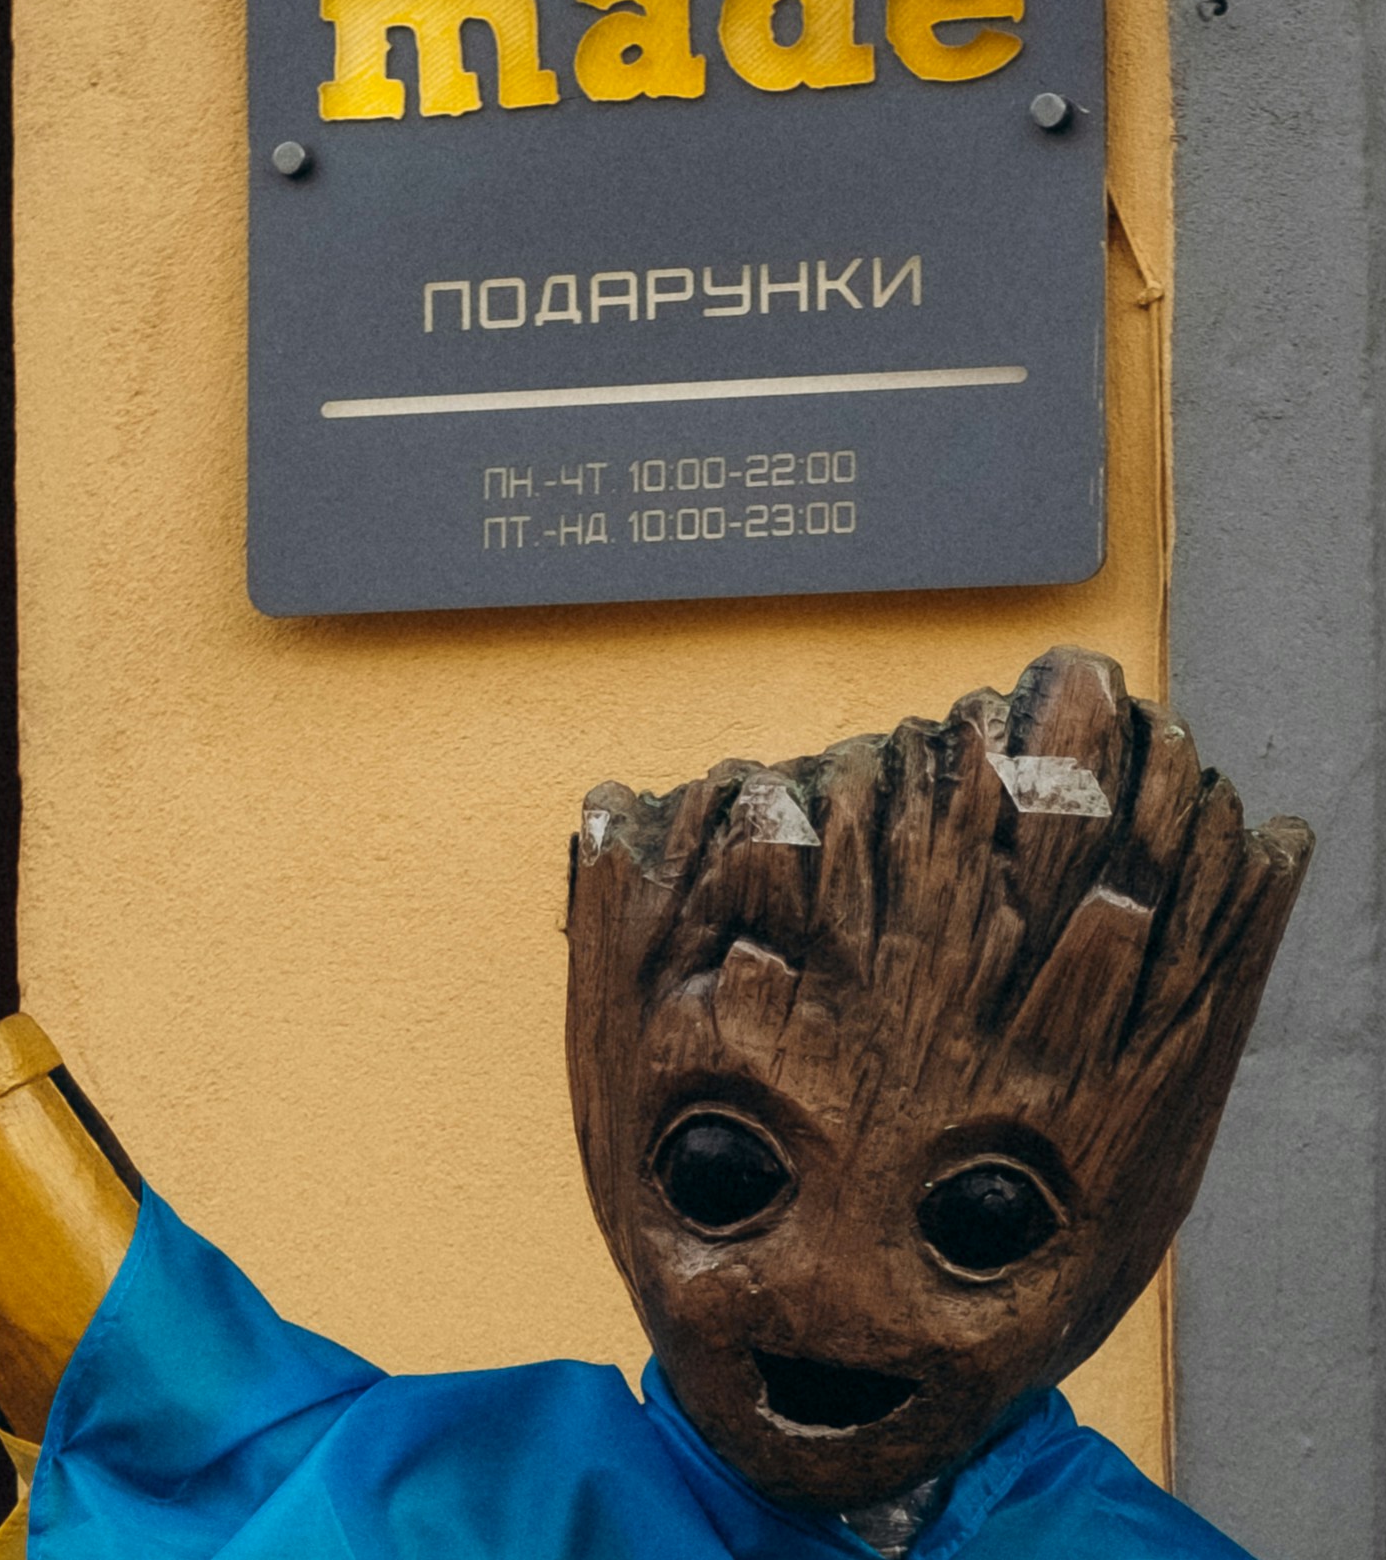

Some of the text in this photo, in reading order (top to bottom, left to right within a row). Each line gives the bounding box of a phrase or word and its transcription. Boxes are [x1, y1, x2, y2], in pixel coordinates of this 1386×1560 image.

[424, 255, 922, 333] ПОДАРУНКИ
[628, 450, 857, 493] 10:00-22:00
[628, 501, 857, 542] 10:00-23:00
